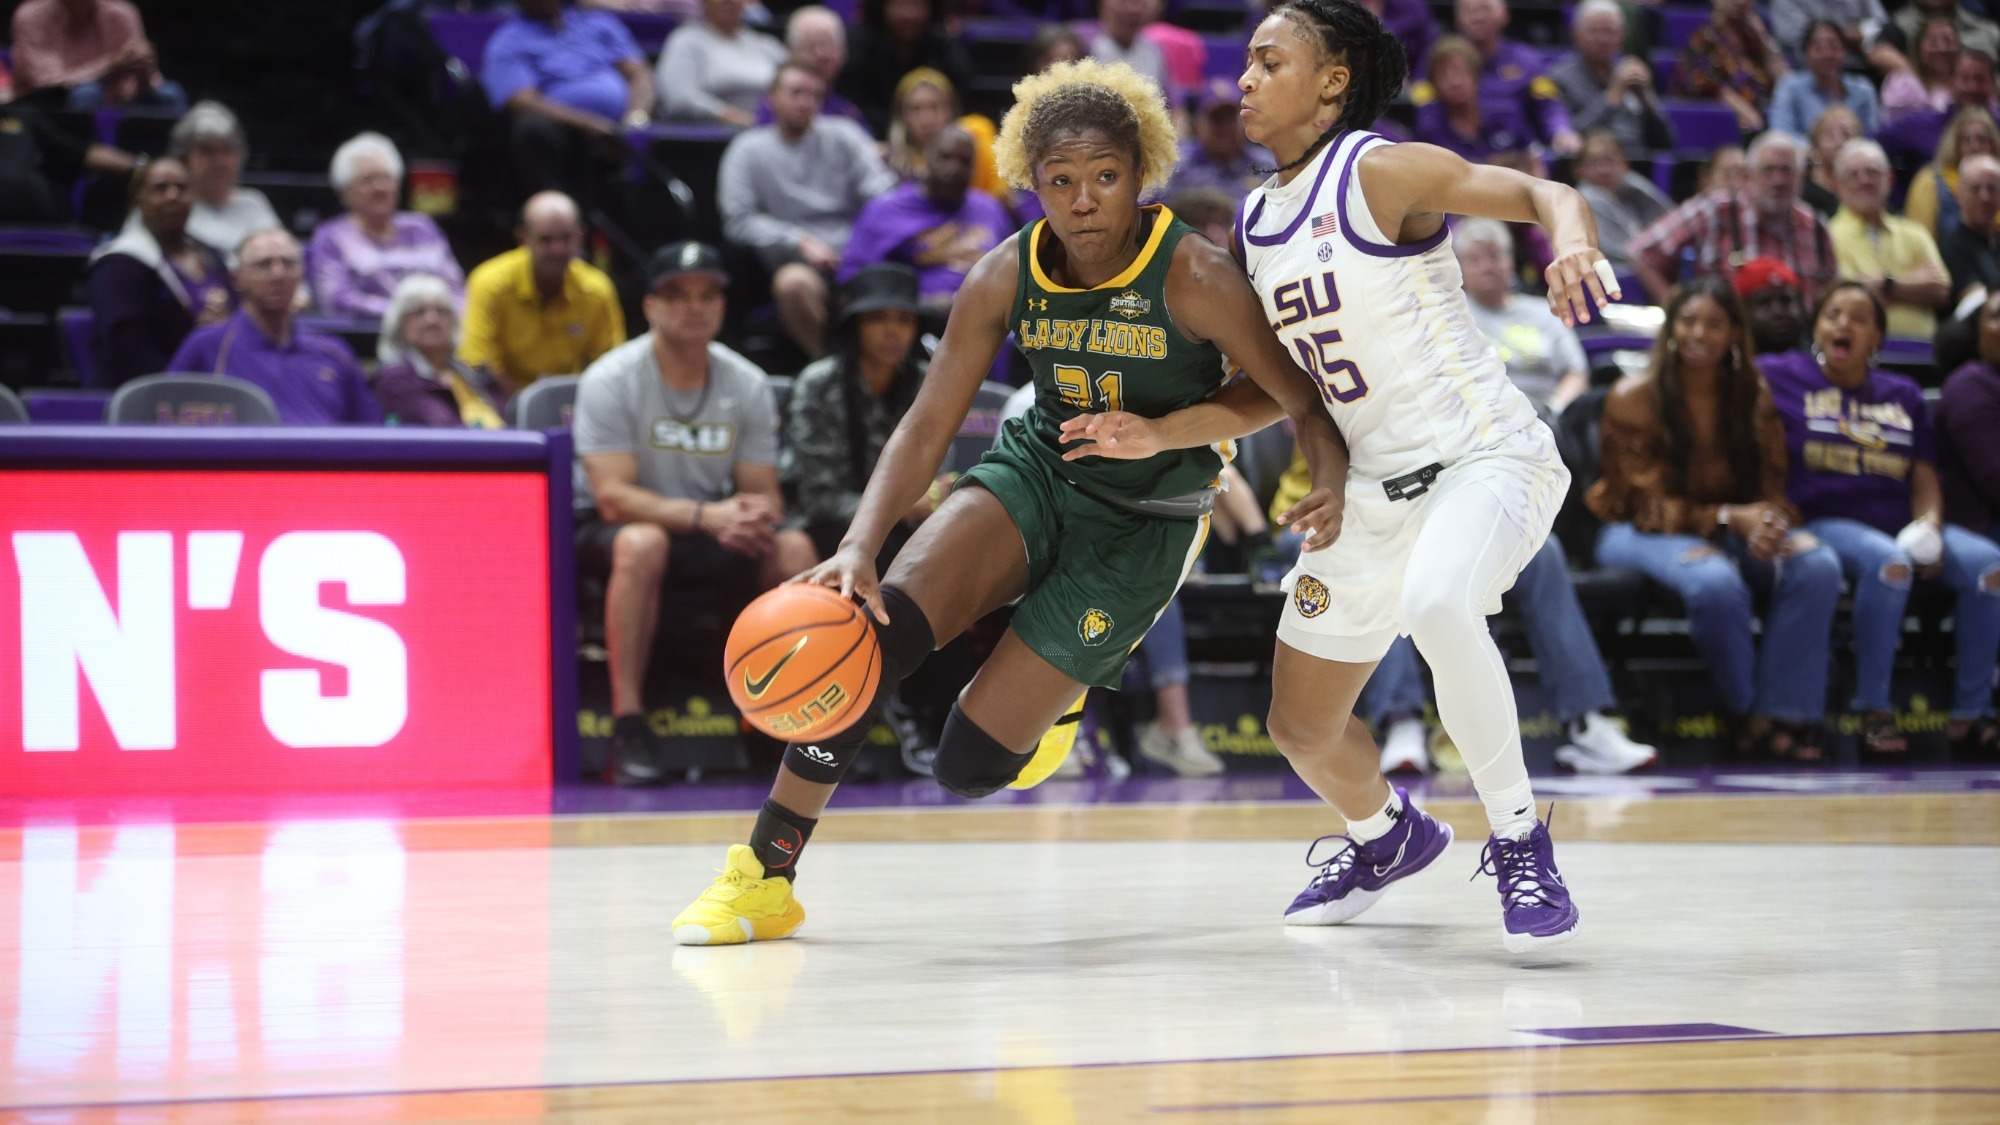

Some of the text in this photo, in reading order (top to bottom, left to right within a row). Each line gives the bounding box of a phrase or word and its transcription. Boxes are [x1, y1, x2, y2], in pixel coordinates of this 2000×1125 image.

[1272, 270, 1342, 332] SU
[1020, 318, 1168, 359] LADY LIONS
[12, 530, 409, 752] N'S
[765, 680, 850, 735] ELITE
